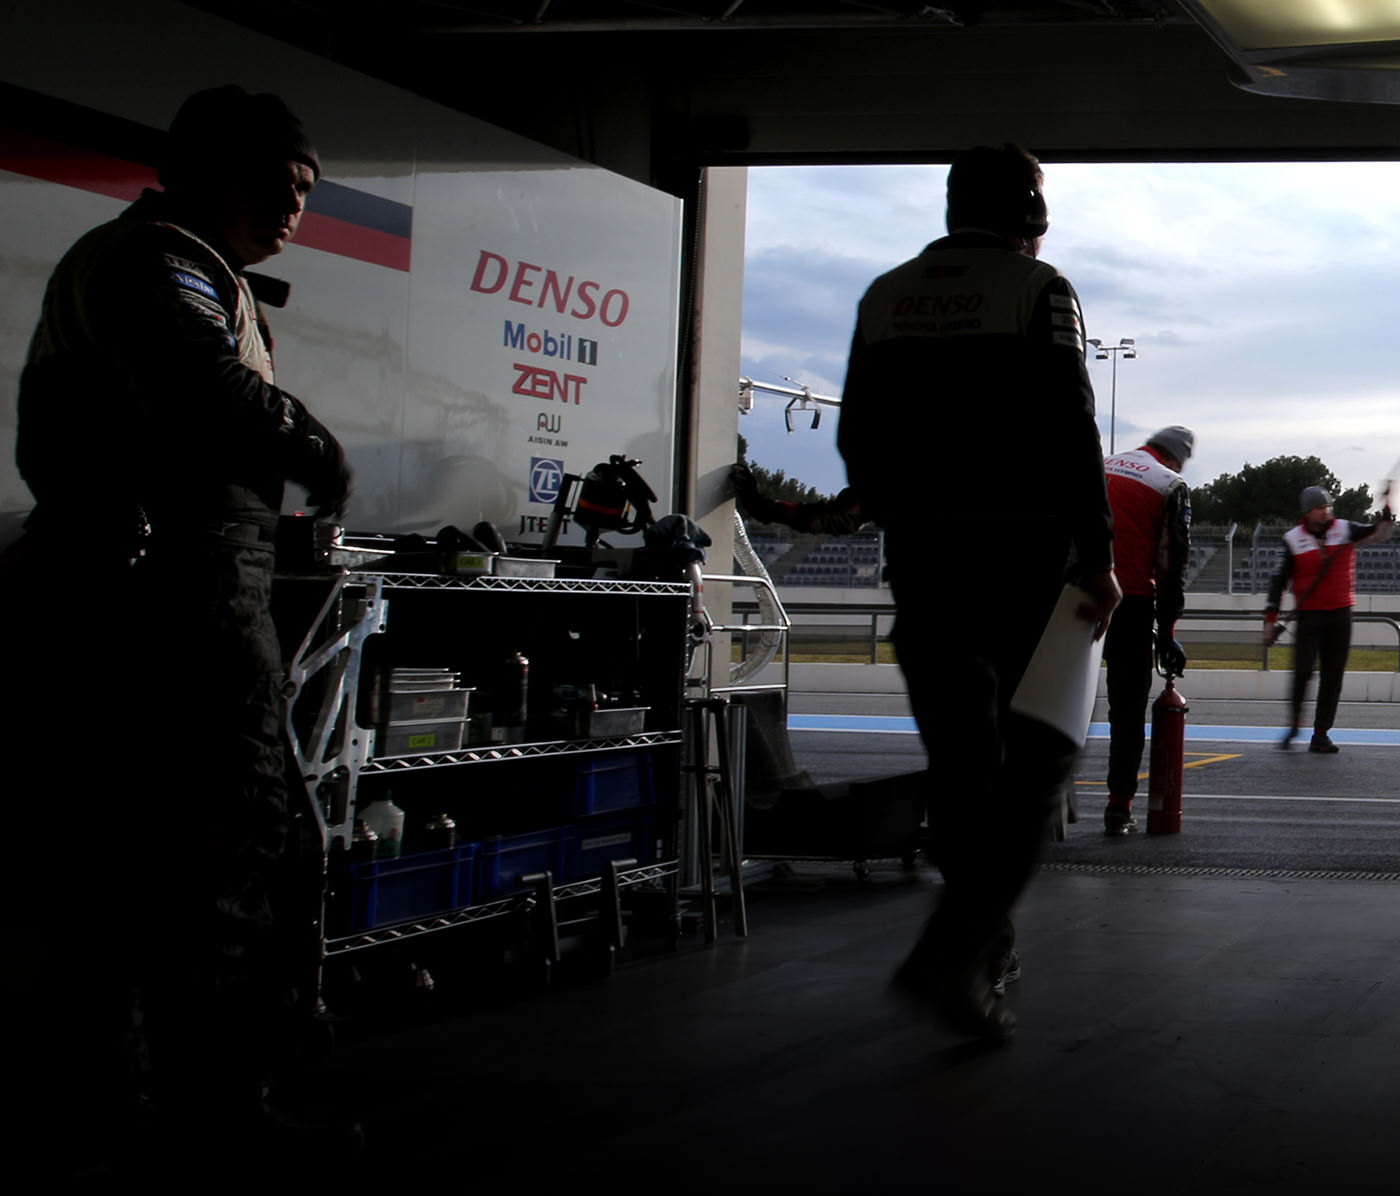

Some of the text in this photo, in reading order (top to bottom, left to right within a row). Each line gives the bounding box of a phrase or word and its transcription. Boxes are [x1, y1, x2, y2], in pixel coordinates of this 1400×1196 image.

[470, 250, 630, 327] DENSO
[893, 293, 984, 316] DENSO
[503, 320, 595, 364] Mobil 1
[512, 363, 588, 405] ZENT
[528, 435, 552, 446] AISIN
[1103, 459, 1150, 472] ENSO
[519, 515, 570, 535] JTET
